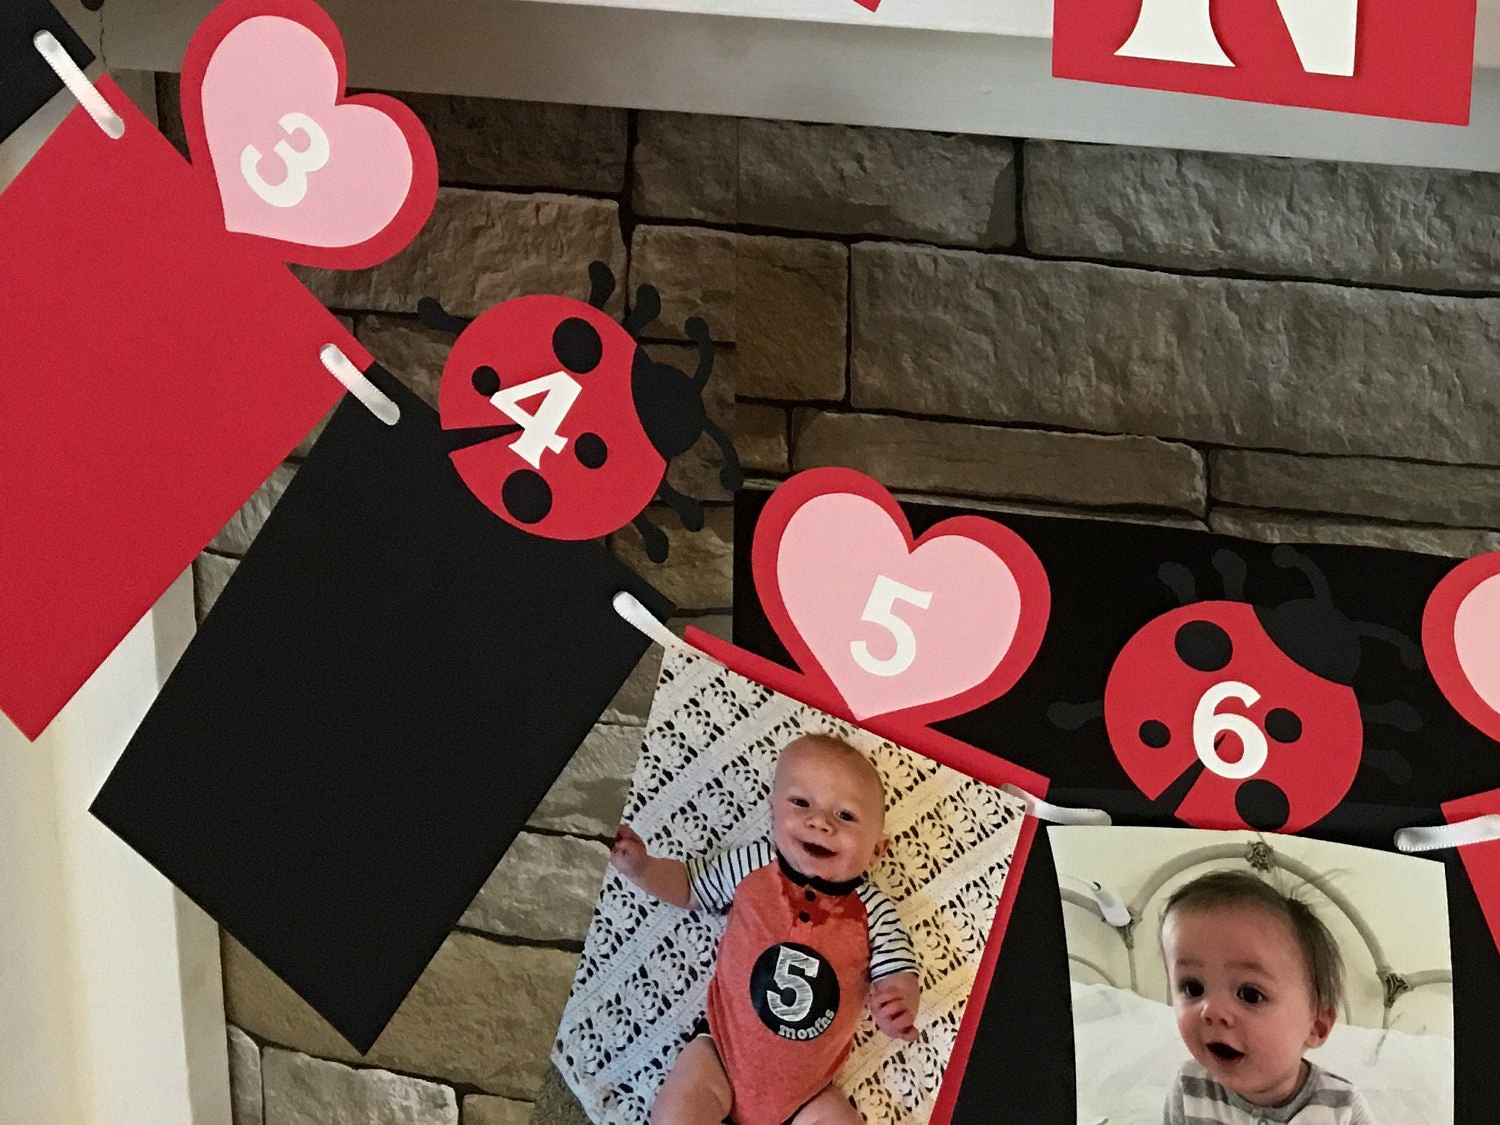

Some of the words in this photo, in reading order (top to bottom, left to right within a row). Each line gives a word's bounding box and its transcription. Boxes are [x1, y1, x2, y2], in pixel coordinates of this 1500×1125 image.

[240, 112, 330, 208] 3
[489, 370, 583, 470] 4
[850, 574, 933, 677] 5
[1192, 680, 1269, 780] 6
[766, 945, 820, 1022] 5
[778, 1009, 835, 1040] months
